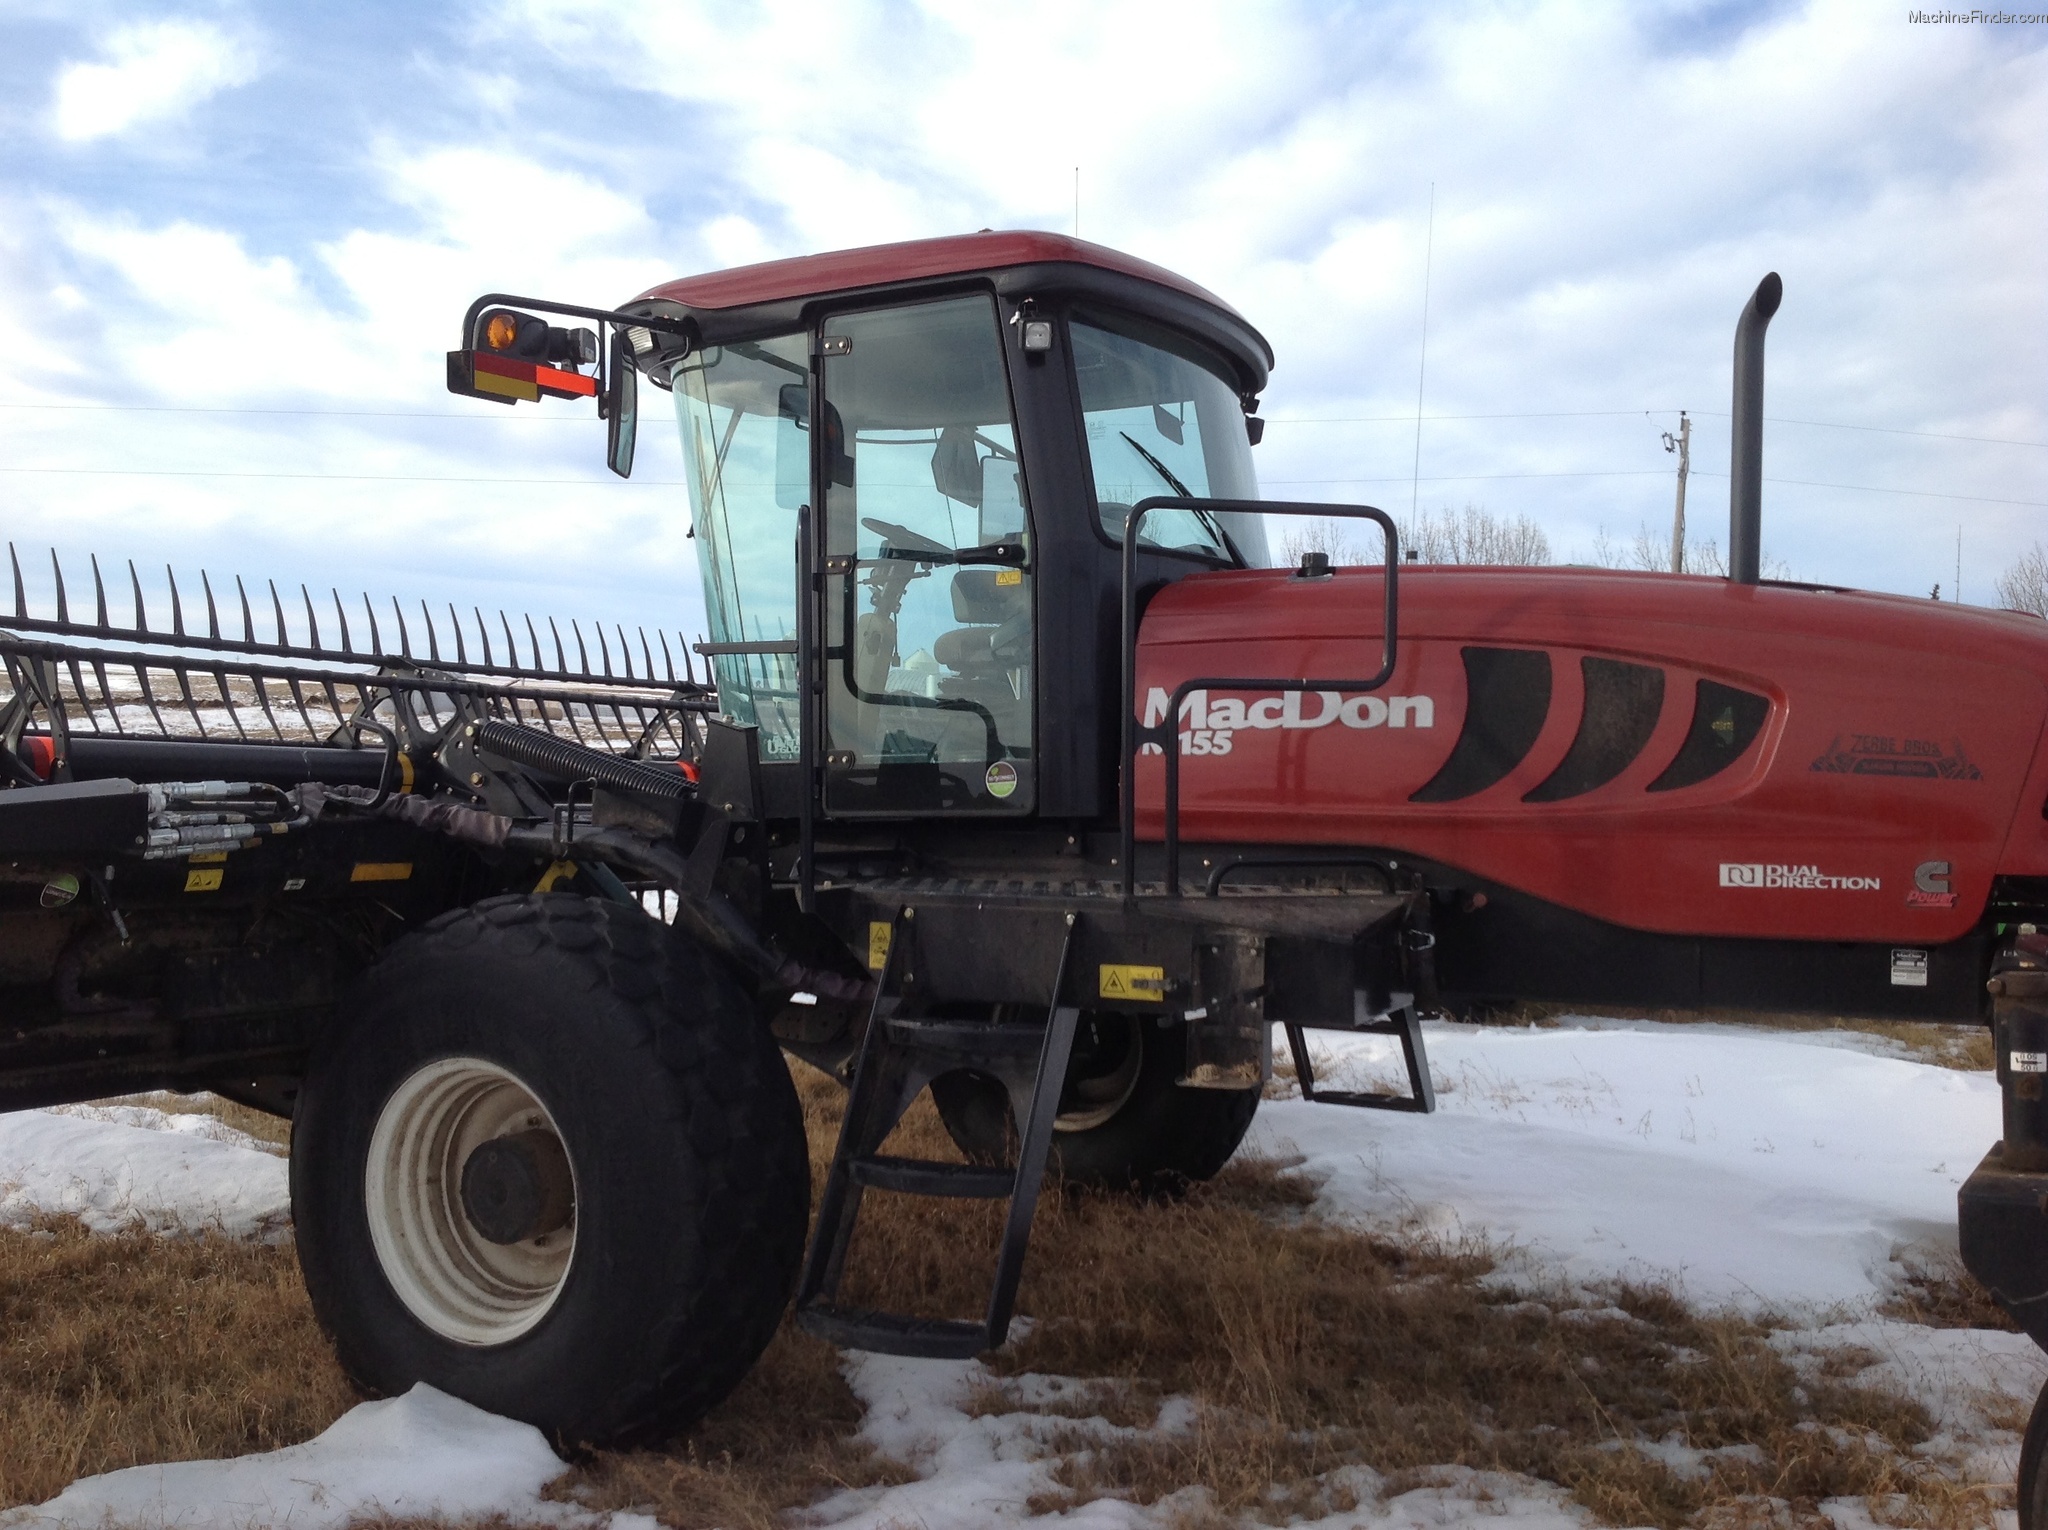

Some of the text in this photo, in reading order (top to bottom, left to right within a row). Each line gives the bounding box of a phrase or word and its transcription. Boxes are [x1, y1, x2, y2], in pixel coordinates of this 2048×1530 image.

[1144, 687, 1434, 730] MacDon
[1766, 864, 1823, 877] DUAL
[1766, 875, 1881, 891] DIRECTION
